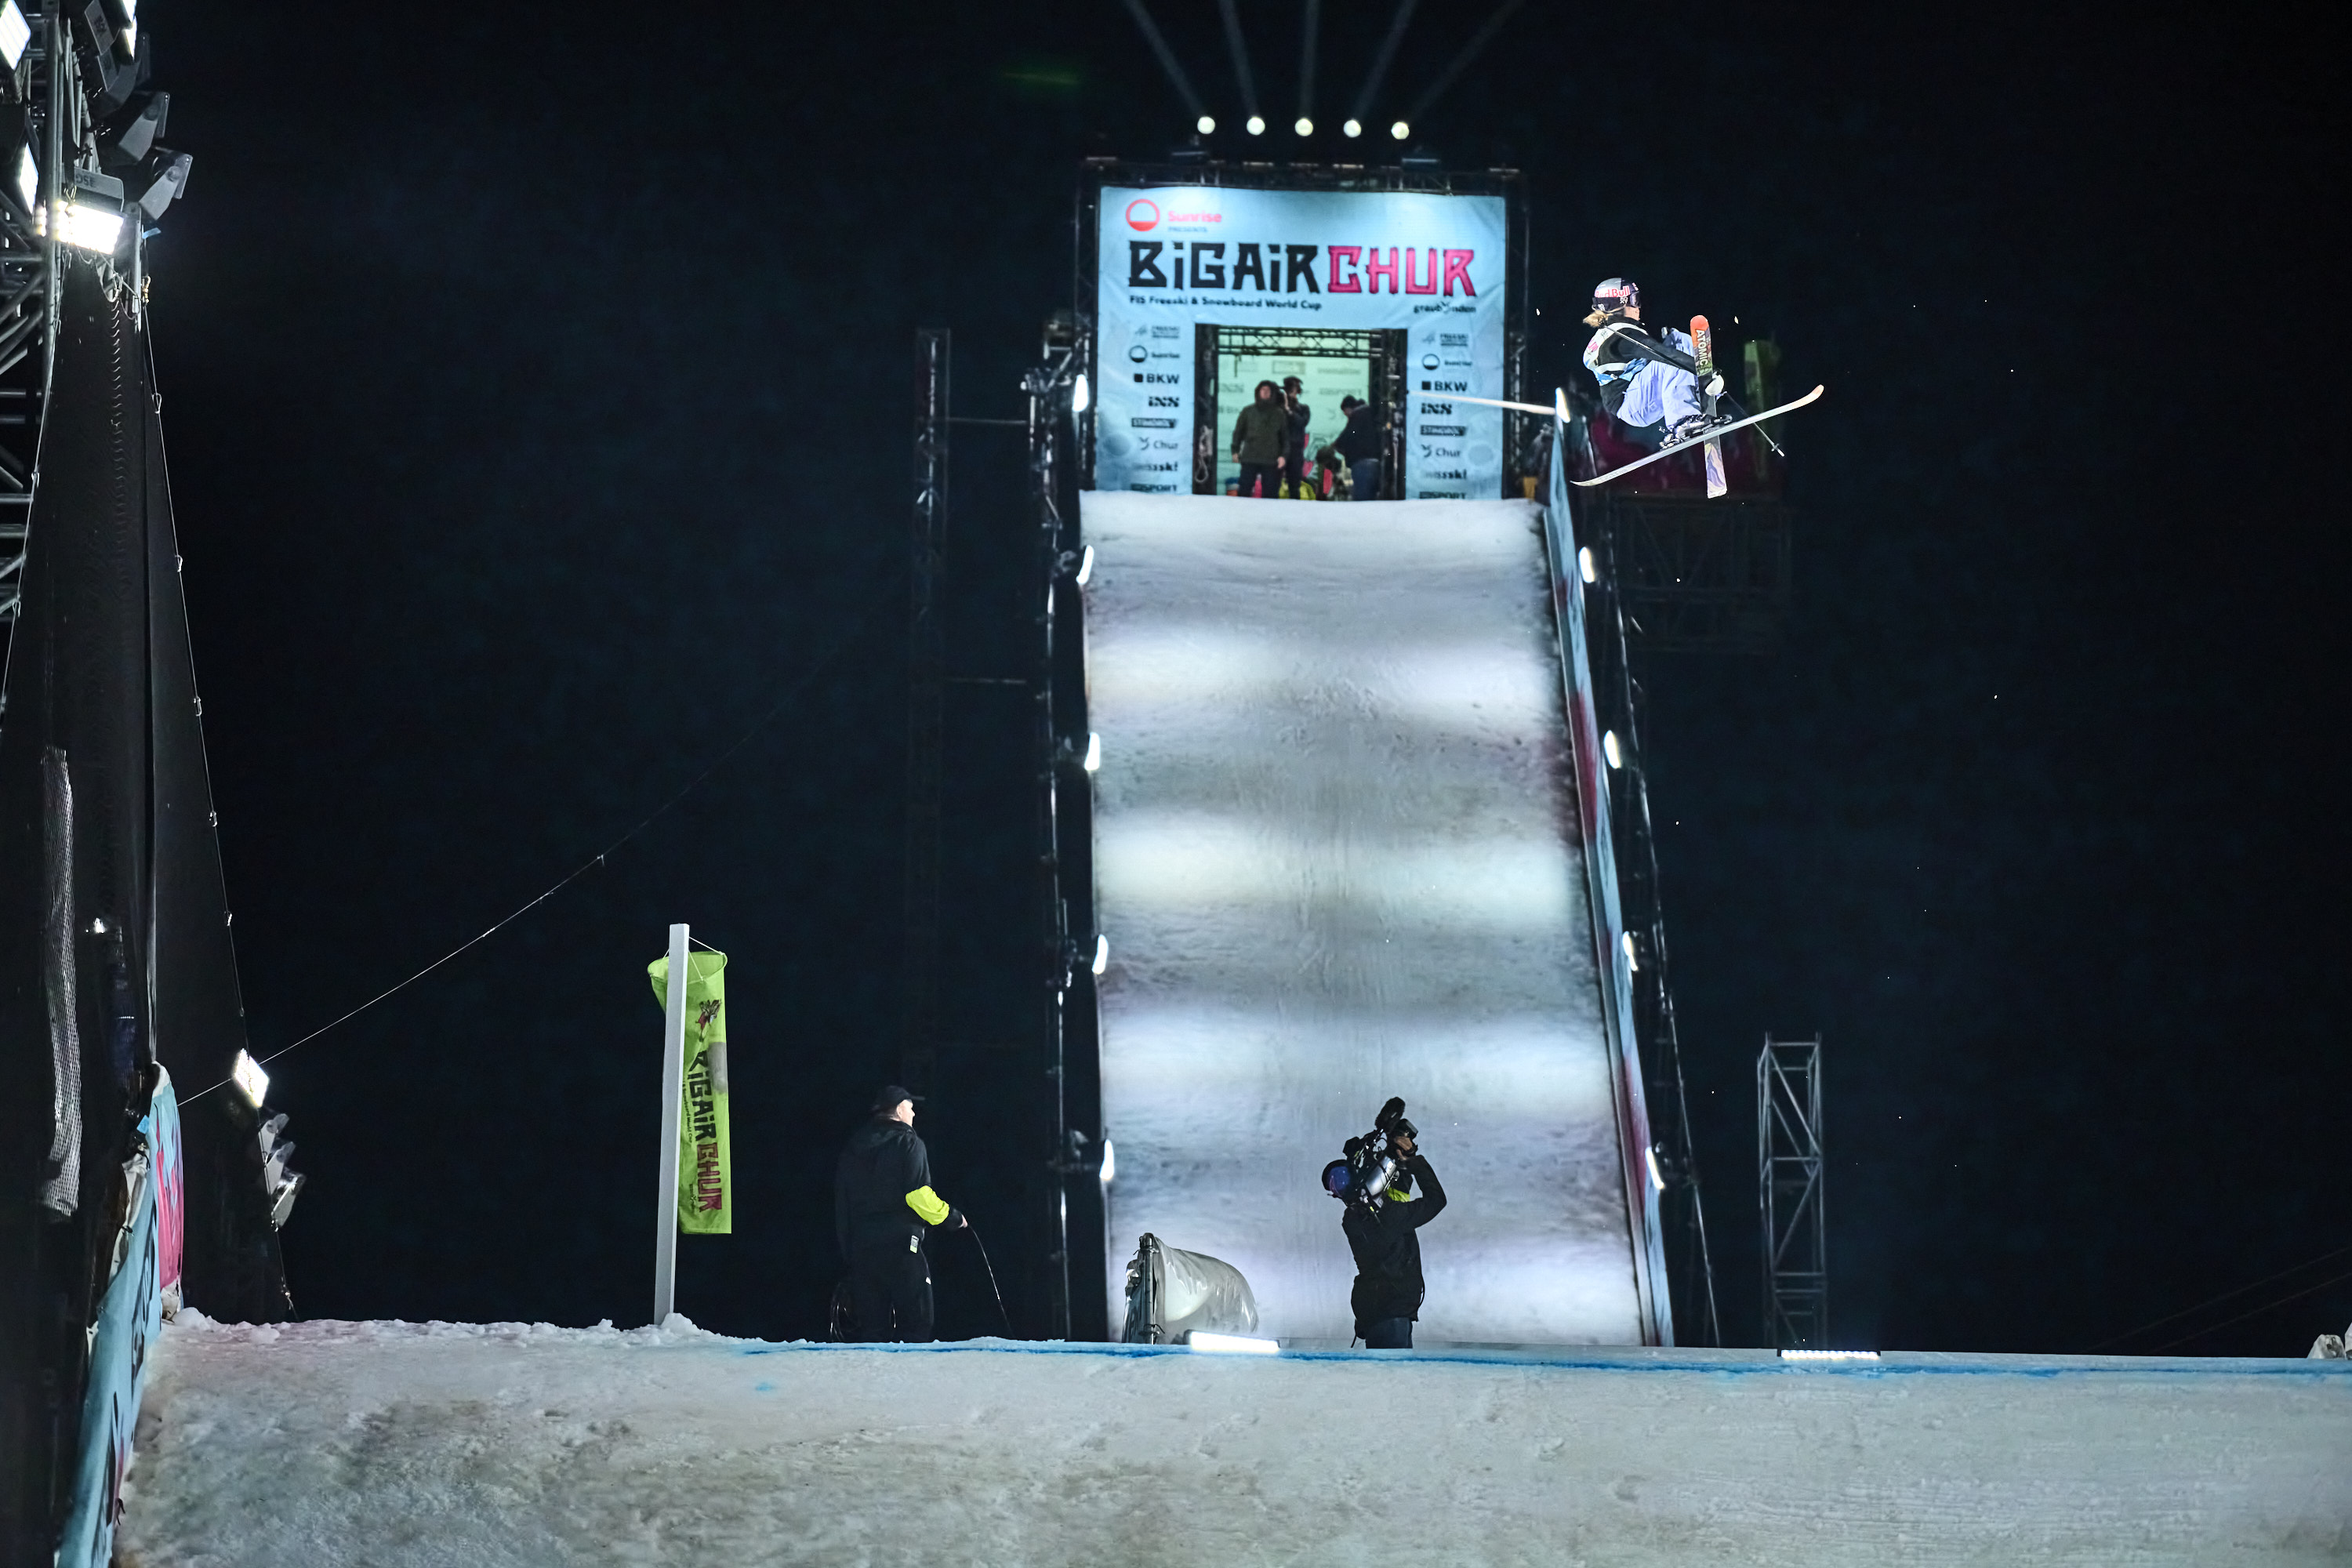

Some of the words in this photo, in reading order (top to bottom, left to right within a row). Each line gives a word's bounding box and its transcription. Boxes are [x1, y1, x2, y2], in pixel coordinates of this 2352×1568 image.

[1168, 210, 1222, 222] Sunrise
[1328, 245, 1477, 296] CHUR
[1612, 285, 1630, 298] Bull
[1130, 295, 1146, 304] FIS
[1149, 296, 1189, 305] Freeski
[1191, 296, 1199, 305] &
[1202, 296, 1263, 308] Snowboard
[1265, 299, 1298, 310] World
[1301, 299, 1323, 311] Cup
[1696, 329, 1708, 366] ATOMIC
[1146, 373, 1179, 384] BKW
[1434, 381, 1468, 391] BKW
[1153, 441, 1178, 449] Chur
[1436, 448, 1460, 457] Chur
[697, 1142, 722, 1213] CHUR
